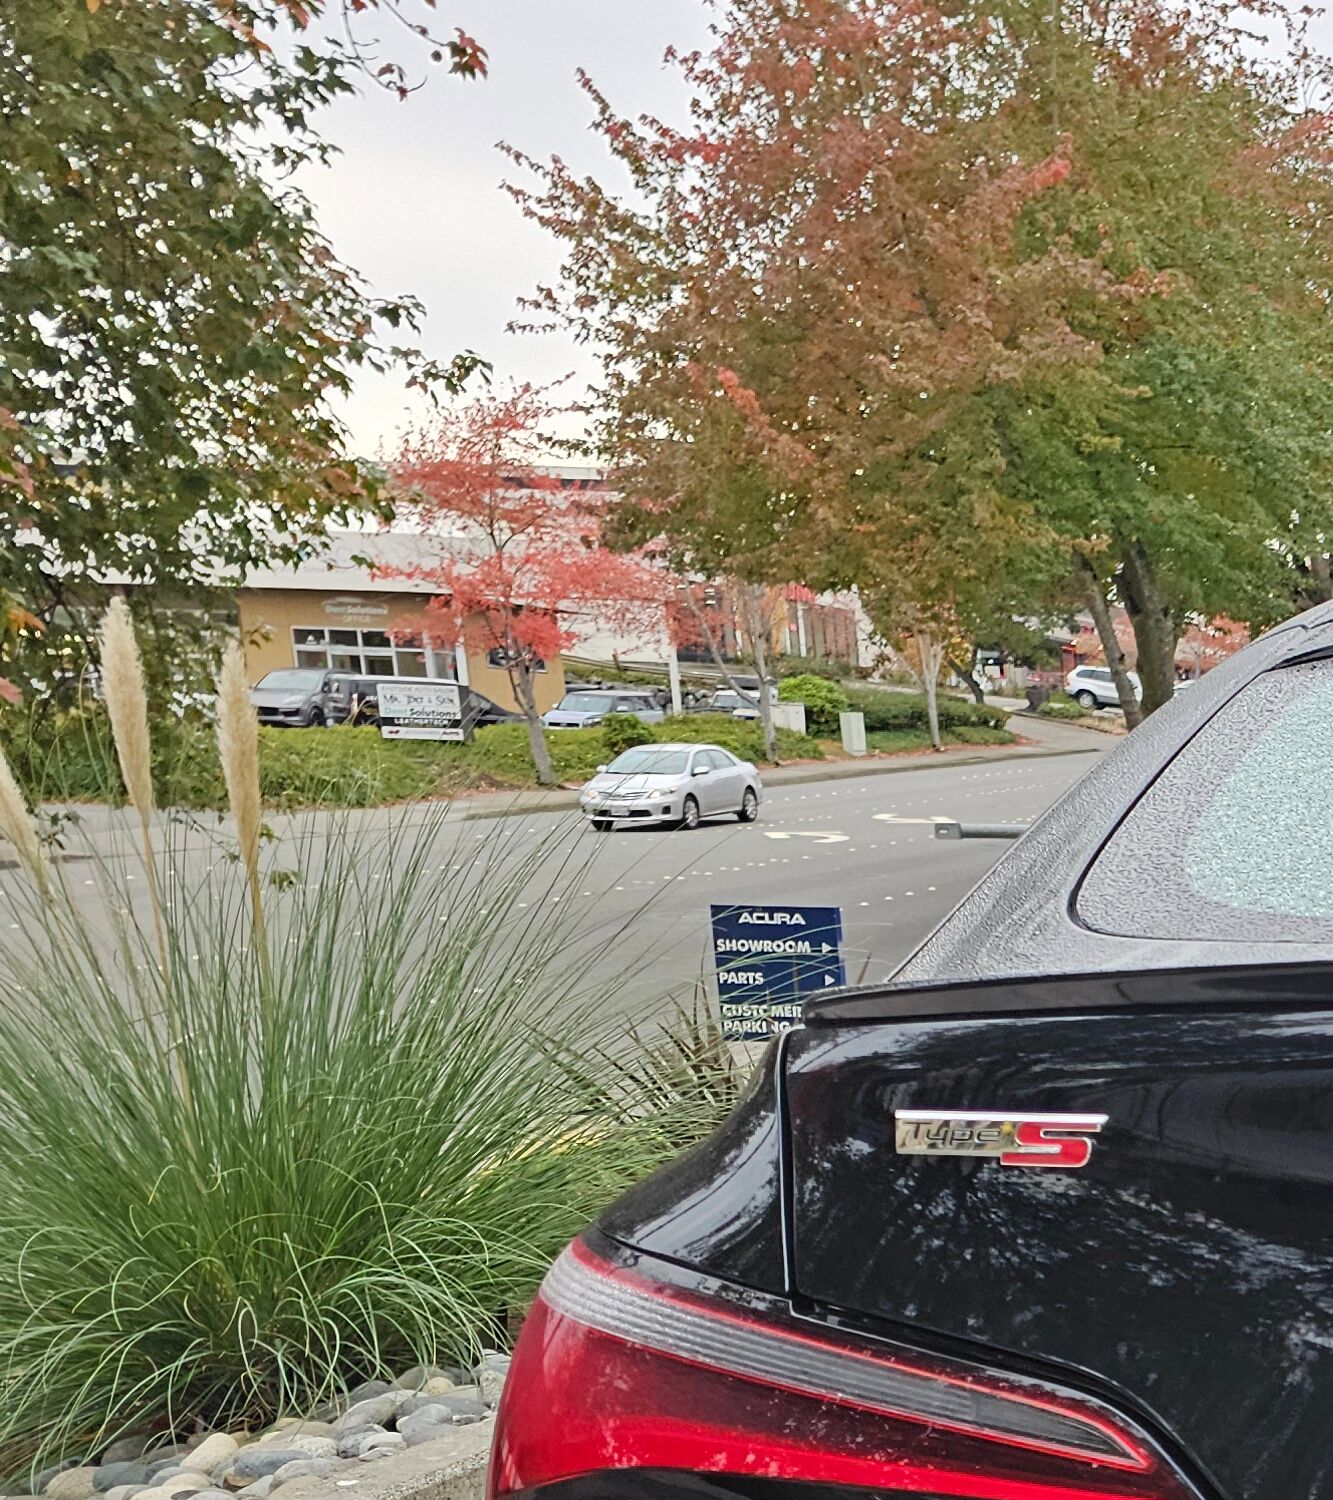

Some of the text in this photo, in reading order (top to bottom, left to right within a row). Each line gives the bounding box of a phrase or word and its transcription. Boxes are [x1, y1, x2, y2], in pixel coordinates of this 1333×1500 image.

[409, 707, 457, 718] Solutions
[738, 912, 807, 926] ACURA
[716, 938, 812, 954] SHOWROOM
[718, 971, 764, 985] PARTS
[904, 1121, 1101, 1168] Type S
